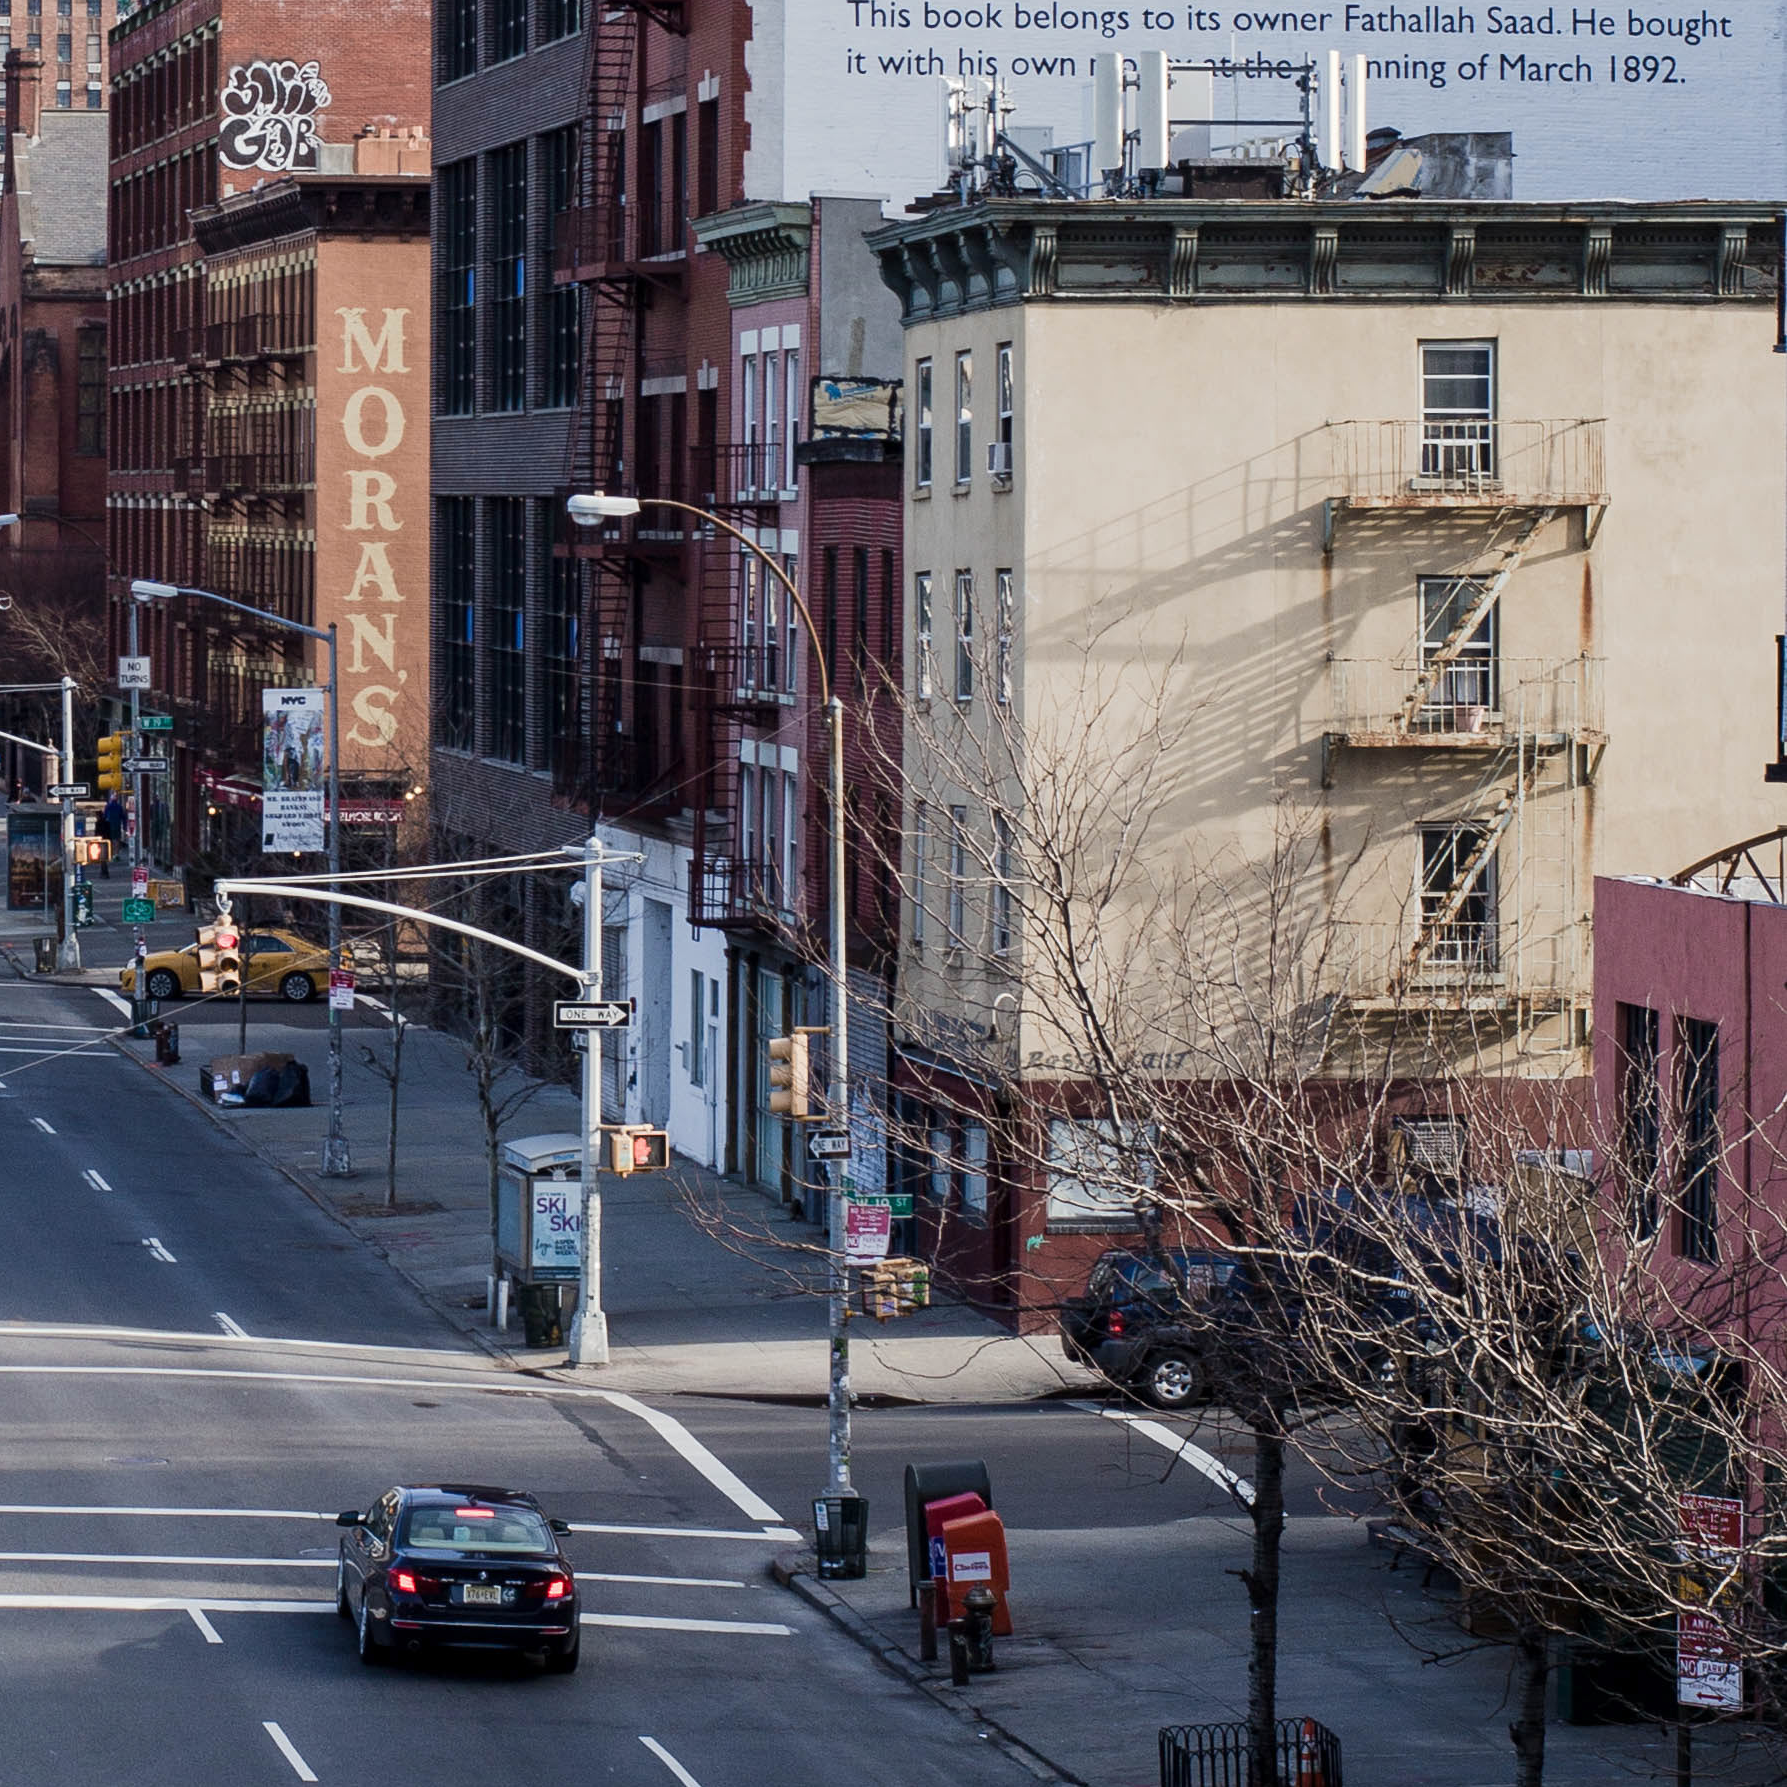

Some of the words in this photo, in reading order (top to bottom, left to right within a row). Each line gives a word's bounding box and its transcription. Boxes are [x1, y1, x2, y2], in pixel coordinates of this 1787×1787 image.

[846, 0, 911, 28] This
[924, 1, 1003, 29] book
[1015, 1, 1130, 39] belongs
[1142, 8, 1175, 30] to
[1187, 4, 1221, 31] its
[1233, 12, 1333, 32] owner
[1345, 4, 1474, 34] Fathallah
[1487, 6, 1563, 35] Saad.
[1572, 8, 1615, 36] He
[1628, 8, 1733, 46] bought
[847, 47, 867, 75] it
[877, 47, 944, 76] with
[958, 47, 998, 77] his
[1011, 57, 1076, 77] own
[1245, 50, 1293, 80] the
[1457, 53, 1490, 81] of
[1499, 53, 1592, 83] March
[1610, 55, 1686, 84] 1892.
[334, 307, 412, 746] MORAN'S
[128, 662, 141, 671] NO
[121, 674, 149, 683] TURNS
[281, 696, 307, 705] NYC
[566, 1009, 587, 1019] ONE
[597, 1010, 619, 1019] WAY
[536, 1197, 567, 1214] SKI
[896, 1197, 908, 1207] ST
[550, 1214, 581, 1232] SKI
[1680, 1659, 1696, 1677] NO
